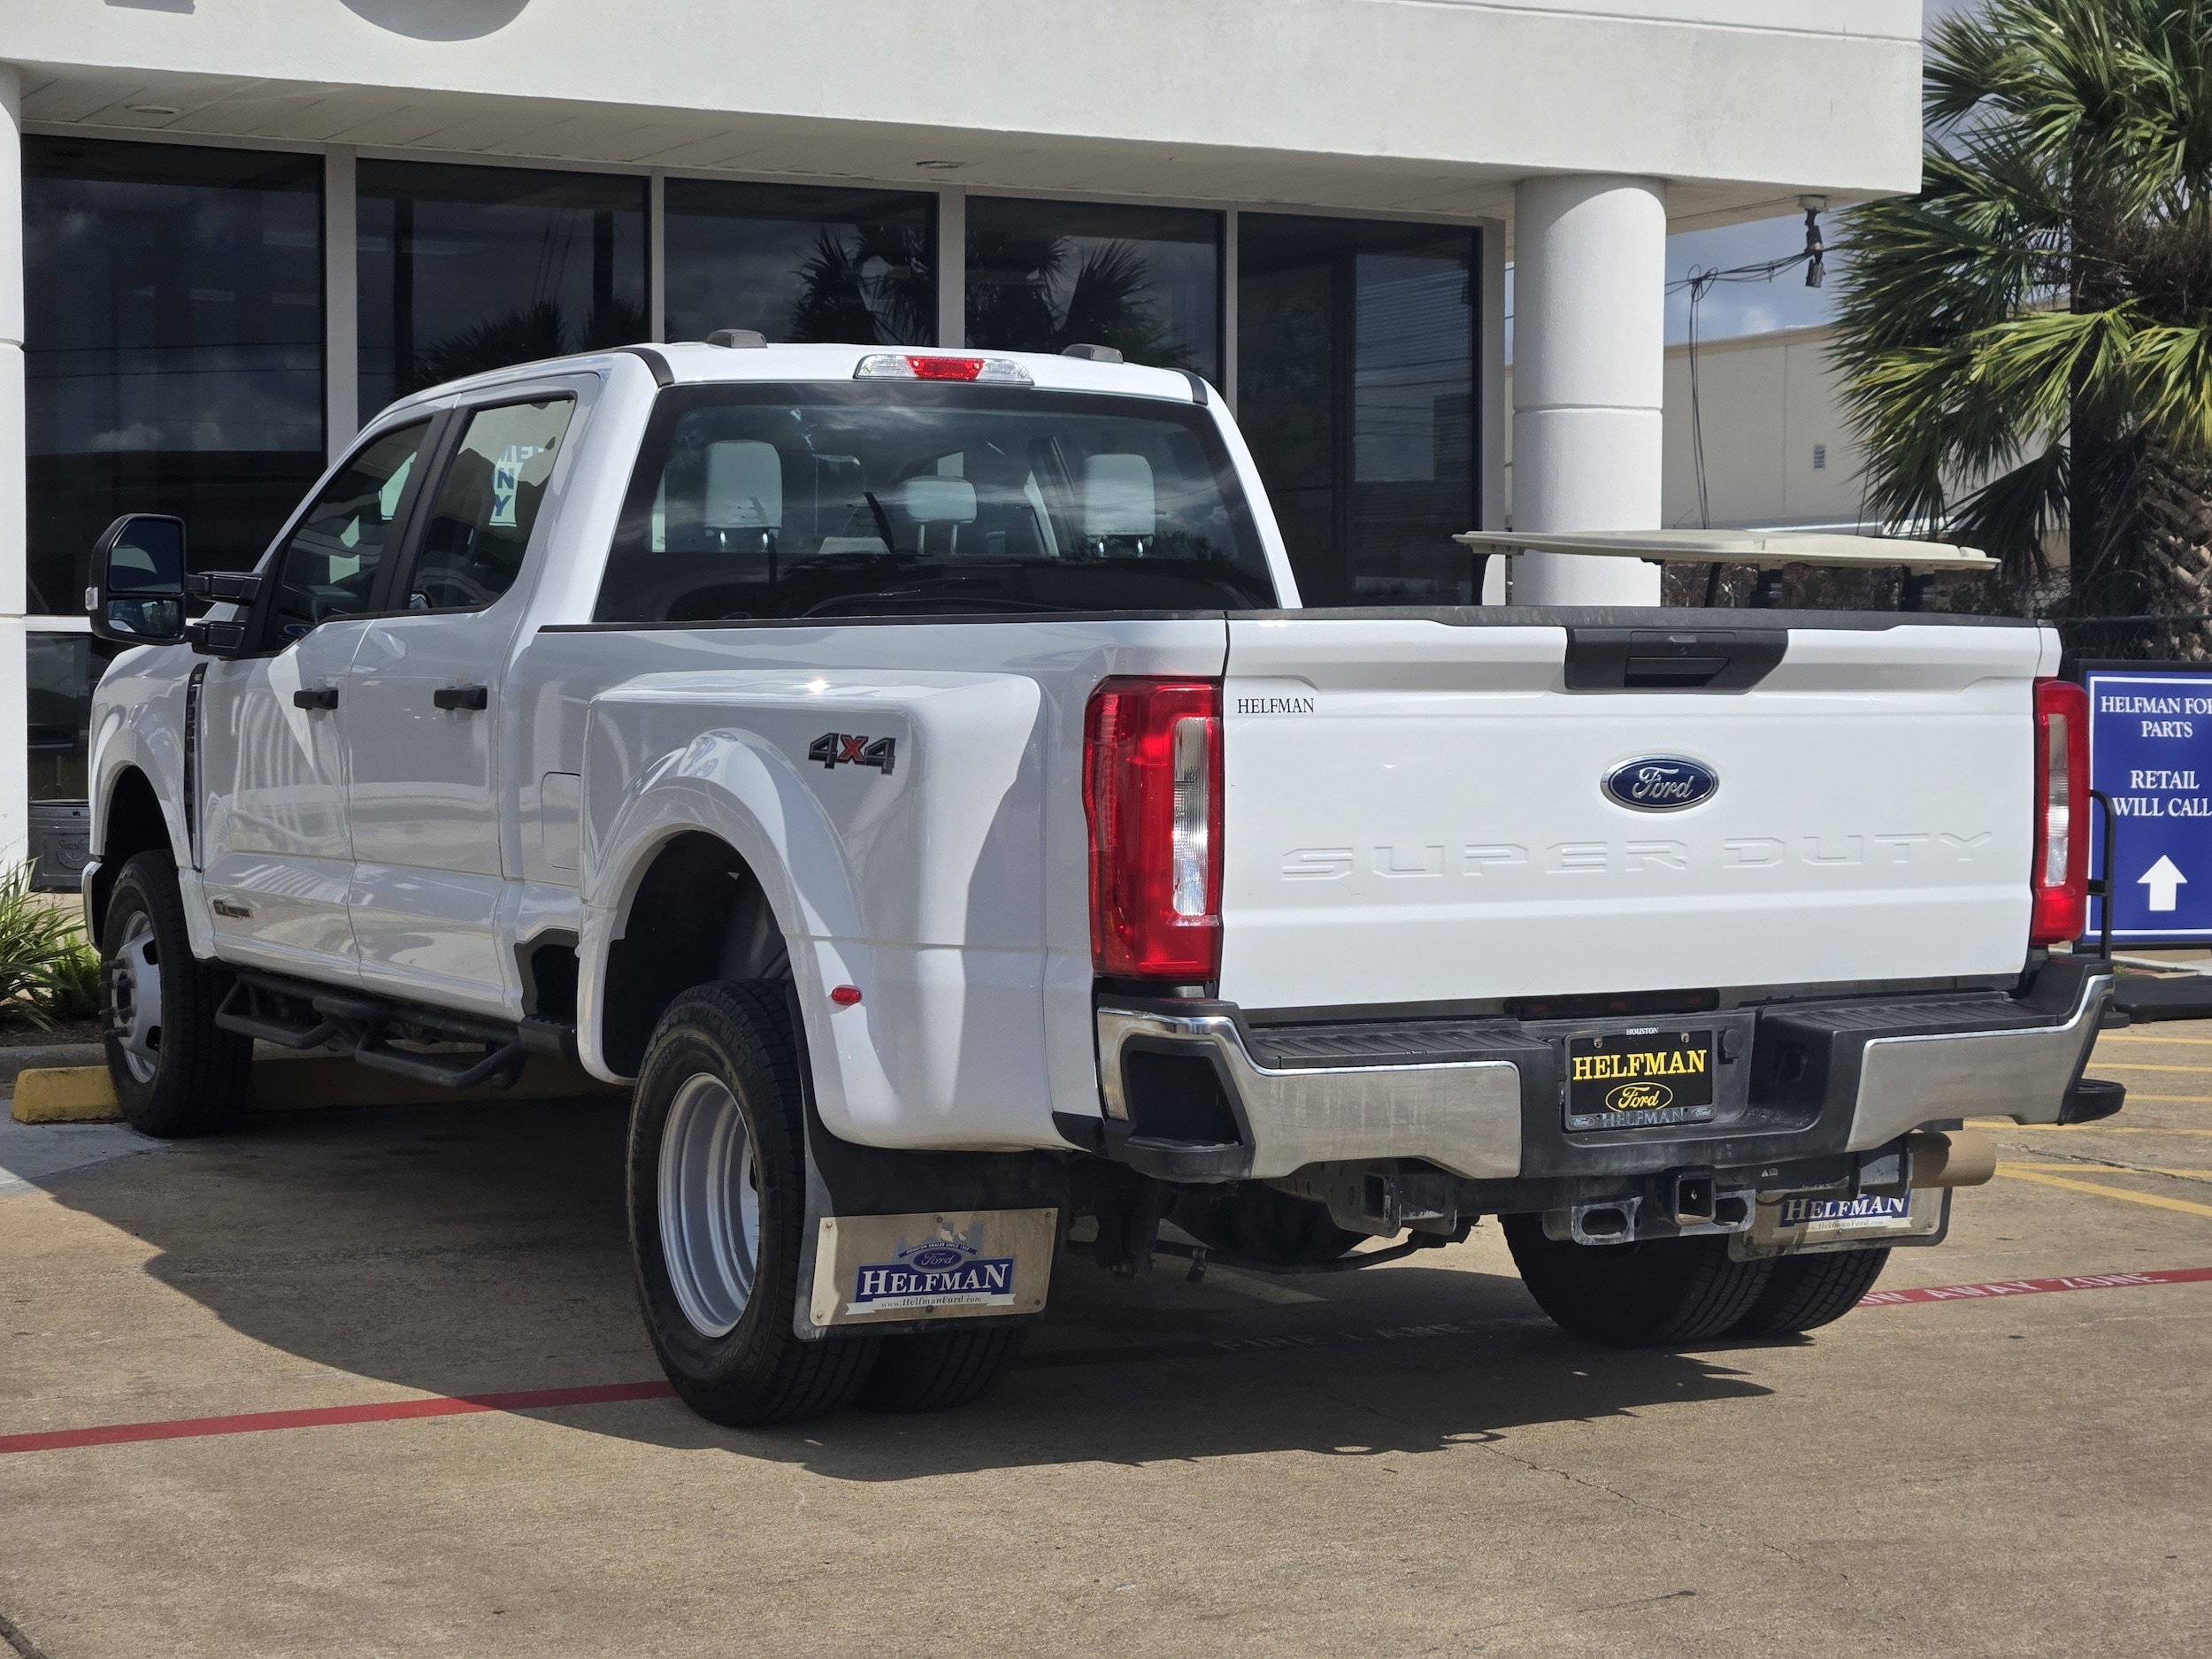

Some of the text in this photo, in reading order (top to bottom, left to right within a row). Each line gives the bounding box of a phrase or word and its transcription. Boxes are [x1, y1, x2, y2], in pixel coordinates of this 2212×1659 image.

[1237, 697, 1315, 714] HELFMAN
[2101, 695, 2181, 714] HELFMAN
[2141, 720, 2193, 738] PARTS
[1632, 766, 1694, 799] Ford
[2130, 769, 2200, 790] RETAIL
[2112, 797, 2212, 817] WILL CALL
[1282, 832, 1993, 880] SUPER DUTY
[1626, 1027, 1660, 1036] HOUSTON
[1572, 1049, 1708, 1081] HELFMAN
[1618, 1086, 1661, 1110] Ford
[1601, 1108, 1685, 1128] HELFMAN
[1785, 1196, 1905, 1221] HELFMAN
[921, 1252, 956, 1266] Ford
[860, 1263, 1010, 1296] HELFMAN
[1858, 1273, 2168, 1305] OW AWAY ZONE
